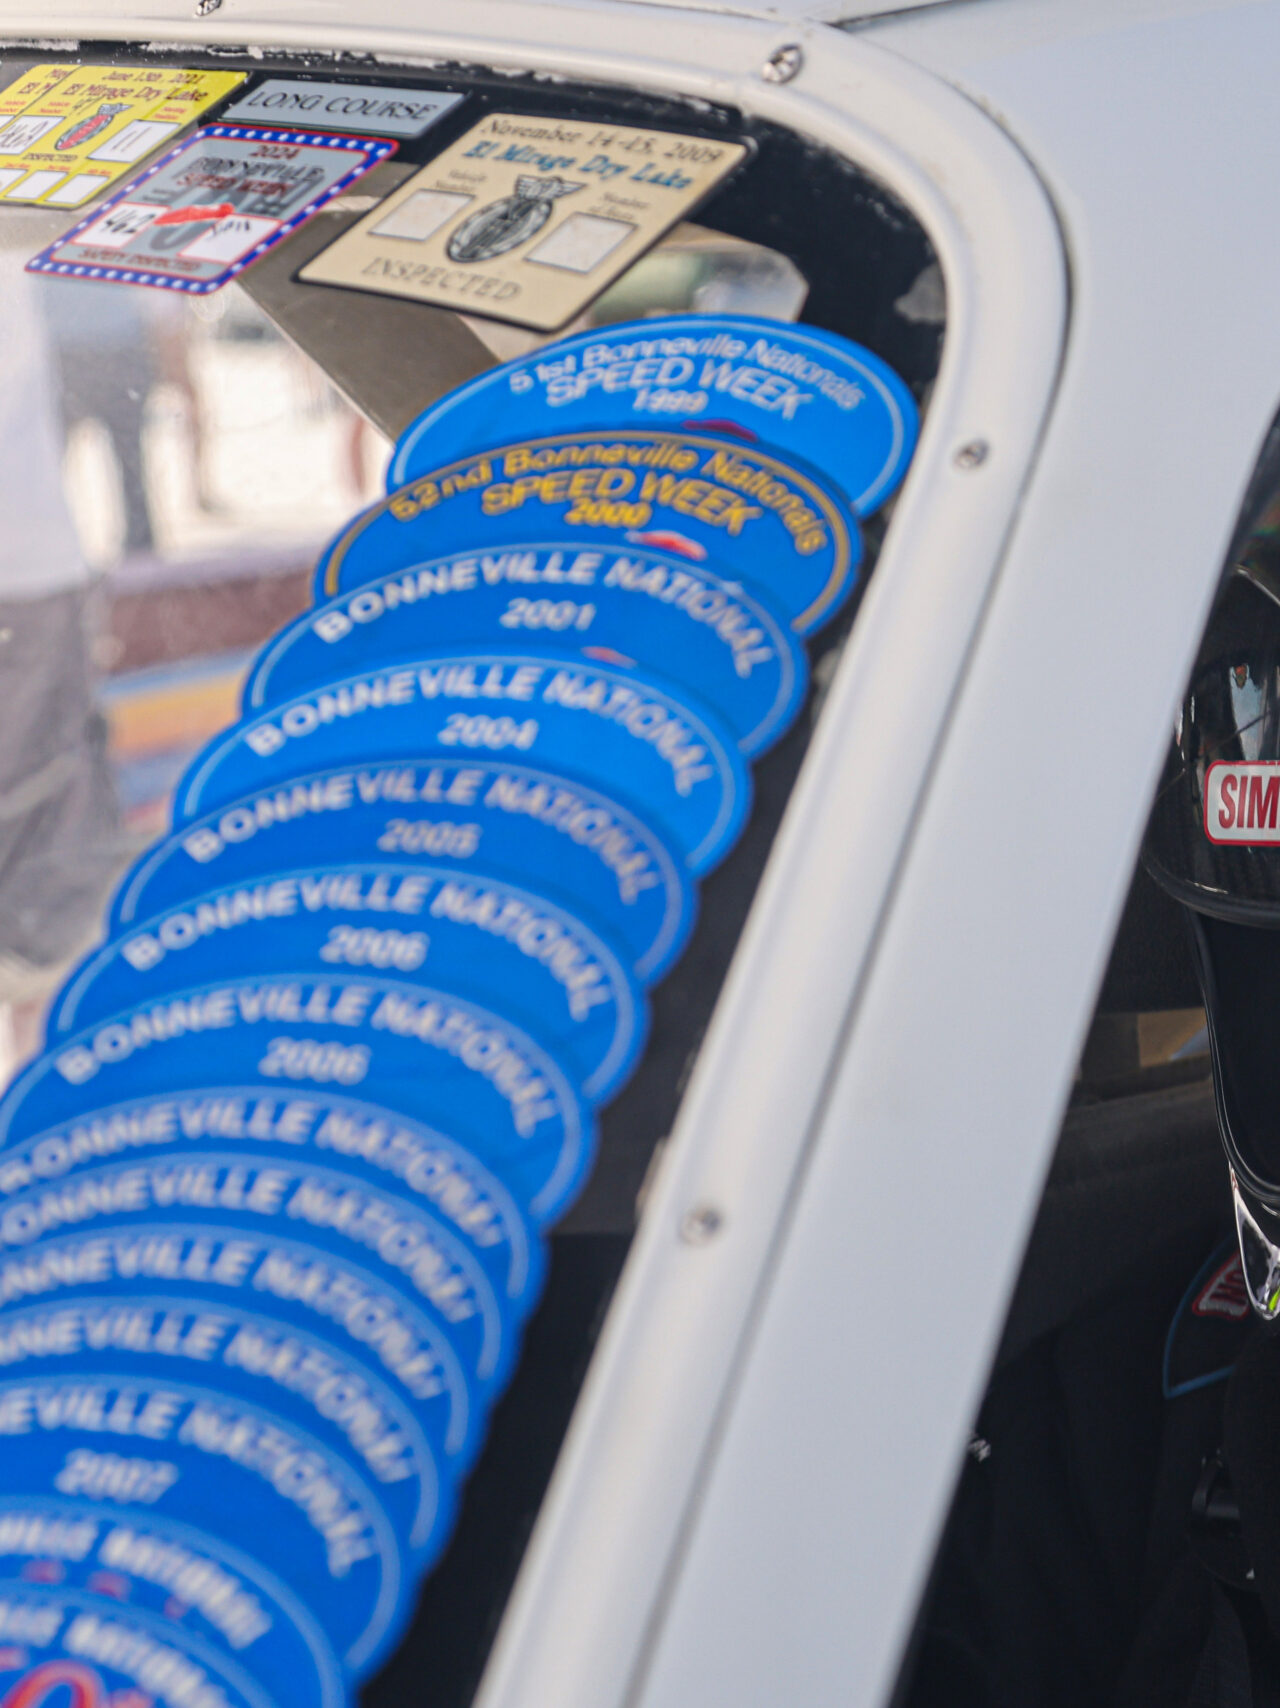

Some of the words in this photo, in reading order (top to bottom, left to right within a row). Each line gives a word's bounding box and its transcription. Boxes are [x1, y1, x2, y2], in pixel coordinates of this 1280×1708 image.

[164, 87, 209, 102] Lake
[248, 91, 323, 111] LONG
[325, 96, 439, 120] COURSE
[462, 141, 497, 159] El
[493, 144, 577, 171] Mirage
[579, 154, 631, 180] Dry
[629, 163, 693, 190] Lake
[481, 118, 583, 144] November
[664, 141, 725, 164] 2009
[362, 257, 522, 301] INSPECTED
[546, 356, 695, 408] SPEED
[699, 359, 815, 421] WEEK
[582, 333, 748, 369] Bonneville
[744, 338, 867, 411] Nationals
[481, 467, 636, 516] SPEED
[639, 473, 764, 537] WEEK
[503, 442, 699, 478] Bonneville
[701, 451, 828, 556] Nationals
[563, 497, 653, 528] 2000
[312, 551, 602, 643] BONNEVILLE
[603, 554, 774, 679] NATIONAL
[500, 597, 597, 632] 2001
[244, 664, 545, 757] BONNEVILLE
[543, 665, 714, 797] NATIONAL
[182, 767, 486, 864] BONNEVILLE
[484, 773, 660, 906] NATIONAL
[121, 873, 434, 972] BONNEVILLE
[430, 881, 611, 1023] NATIONAL
[55, 982, 375, 1085] BONNEVILLE
[371, 989, 556, 1139] NATIONAL
[178, 1402, 380, 1579] NATIONAL
